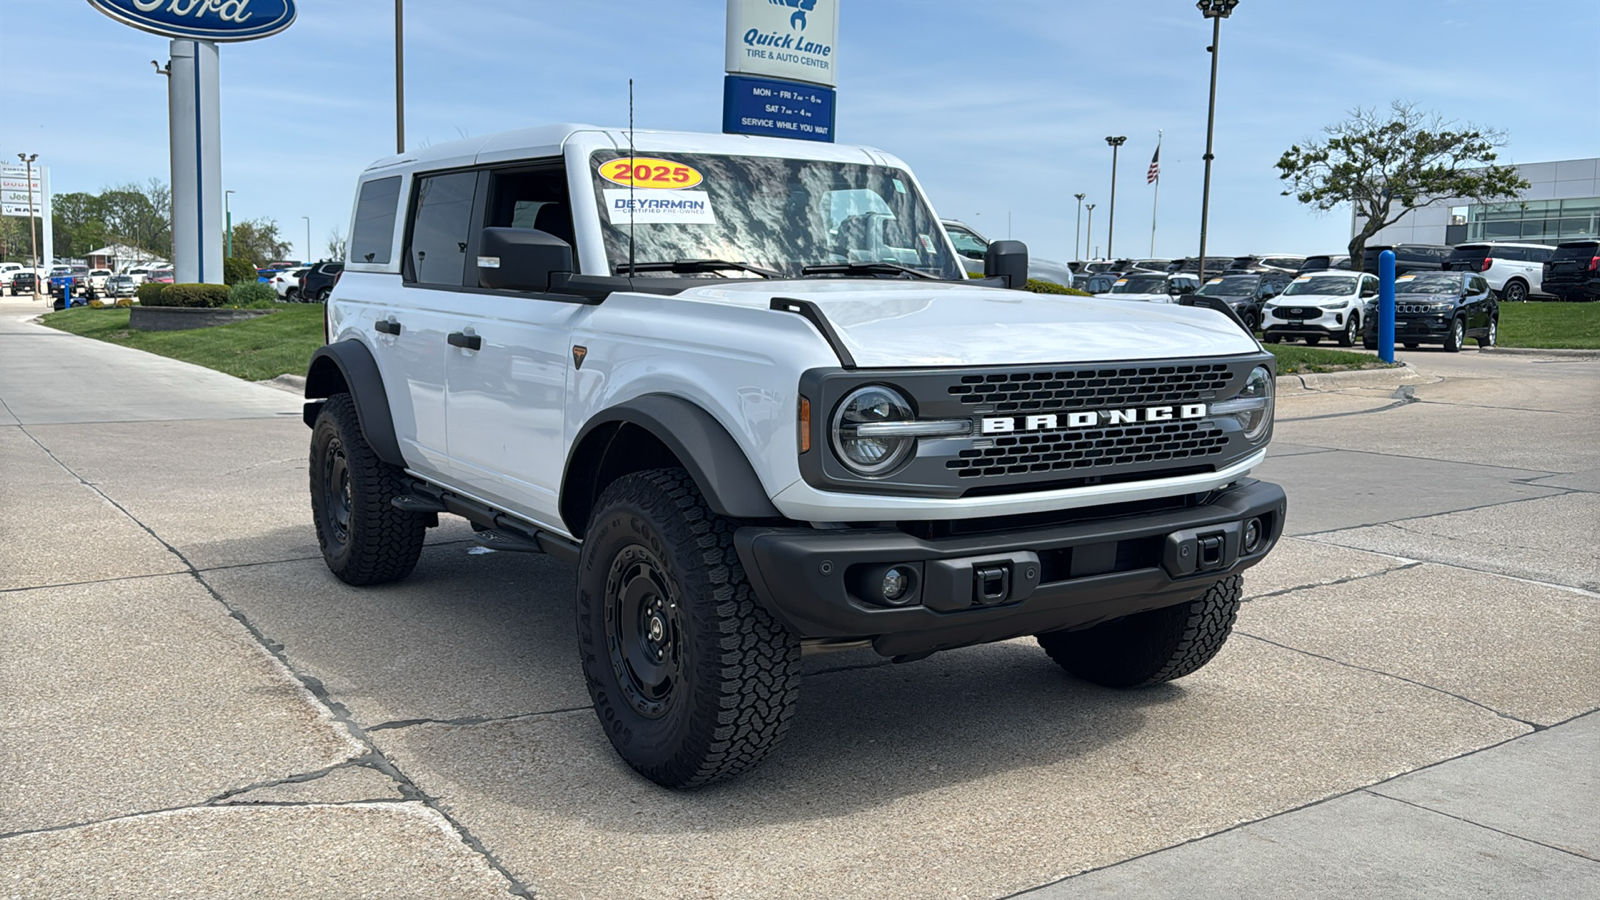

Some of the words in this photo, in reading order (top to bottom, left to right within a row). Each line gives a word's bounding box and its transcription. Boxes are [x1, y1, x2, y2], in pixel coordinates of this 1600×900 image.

[743, 28, 794, 49] Quick
[795, 36, 831, 57] Lane
[746, 48, 766, 59] TIRE
[768, 51, 774, 60] &
[776, 52, 799, 63] AUTO
[800, 56, 829, 70] CENTER
[753, 87, 771, 97] MON
[780, 90, 791, 99] FRI
[765, 104, 779, 113] SAT
[741, 117, 774, 128] SERVICE
[776, 121, 798, 130] WHILE
[799, 123, 813, 133] YOU
[815, 126, 829, 135] WAIT
[613, 163, 690, 183] 2025
[614, 199, 704, 209] DEYARMAN
[981, 403, 1206, 434] BRONCO
